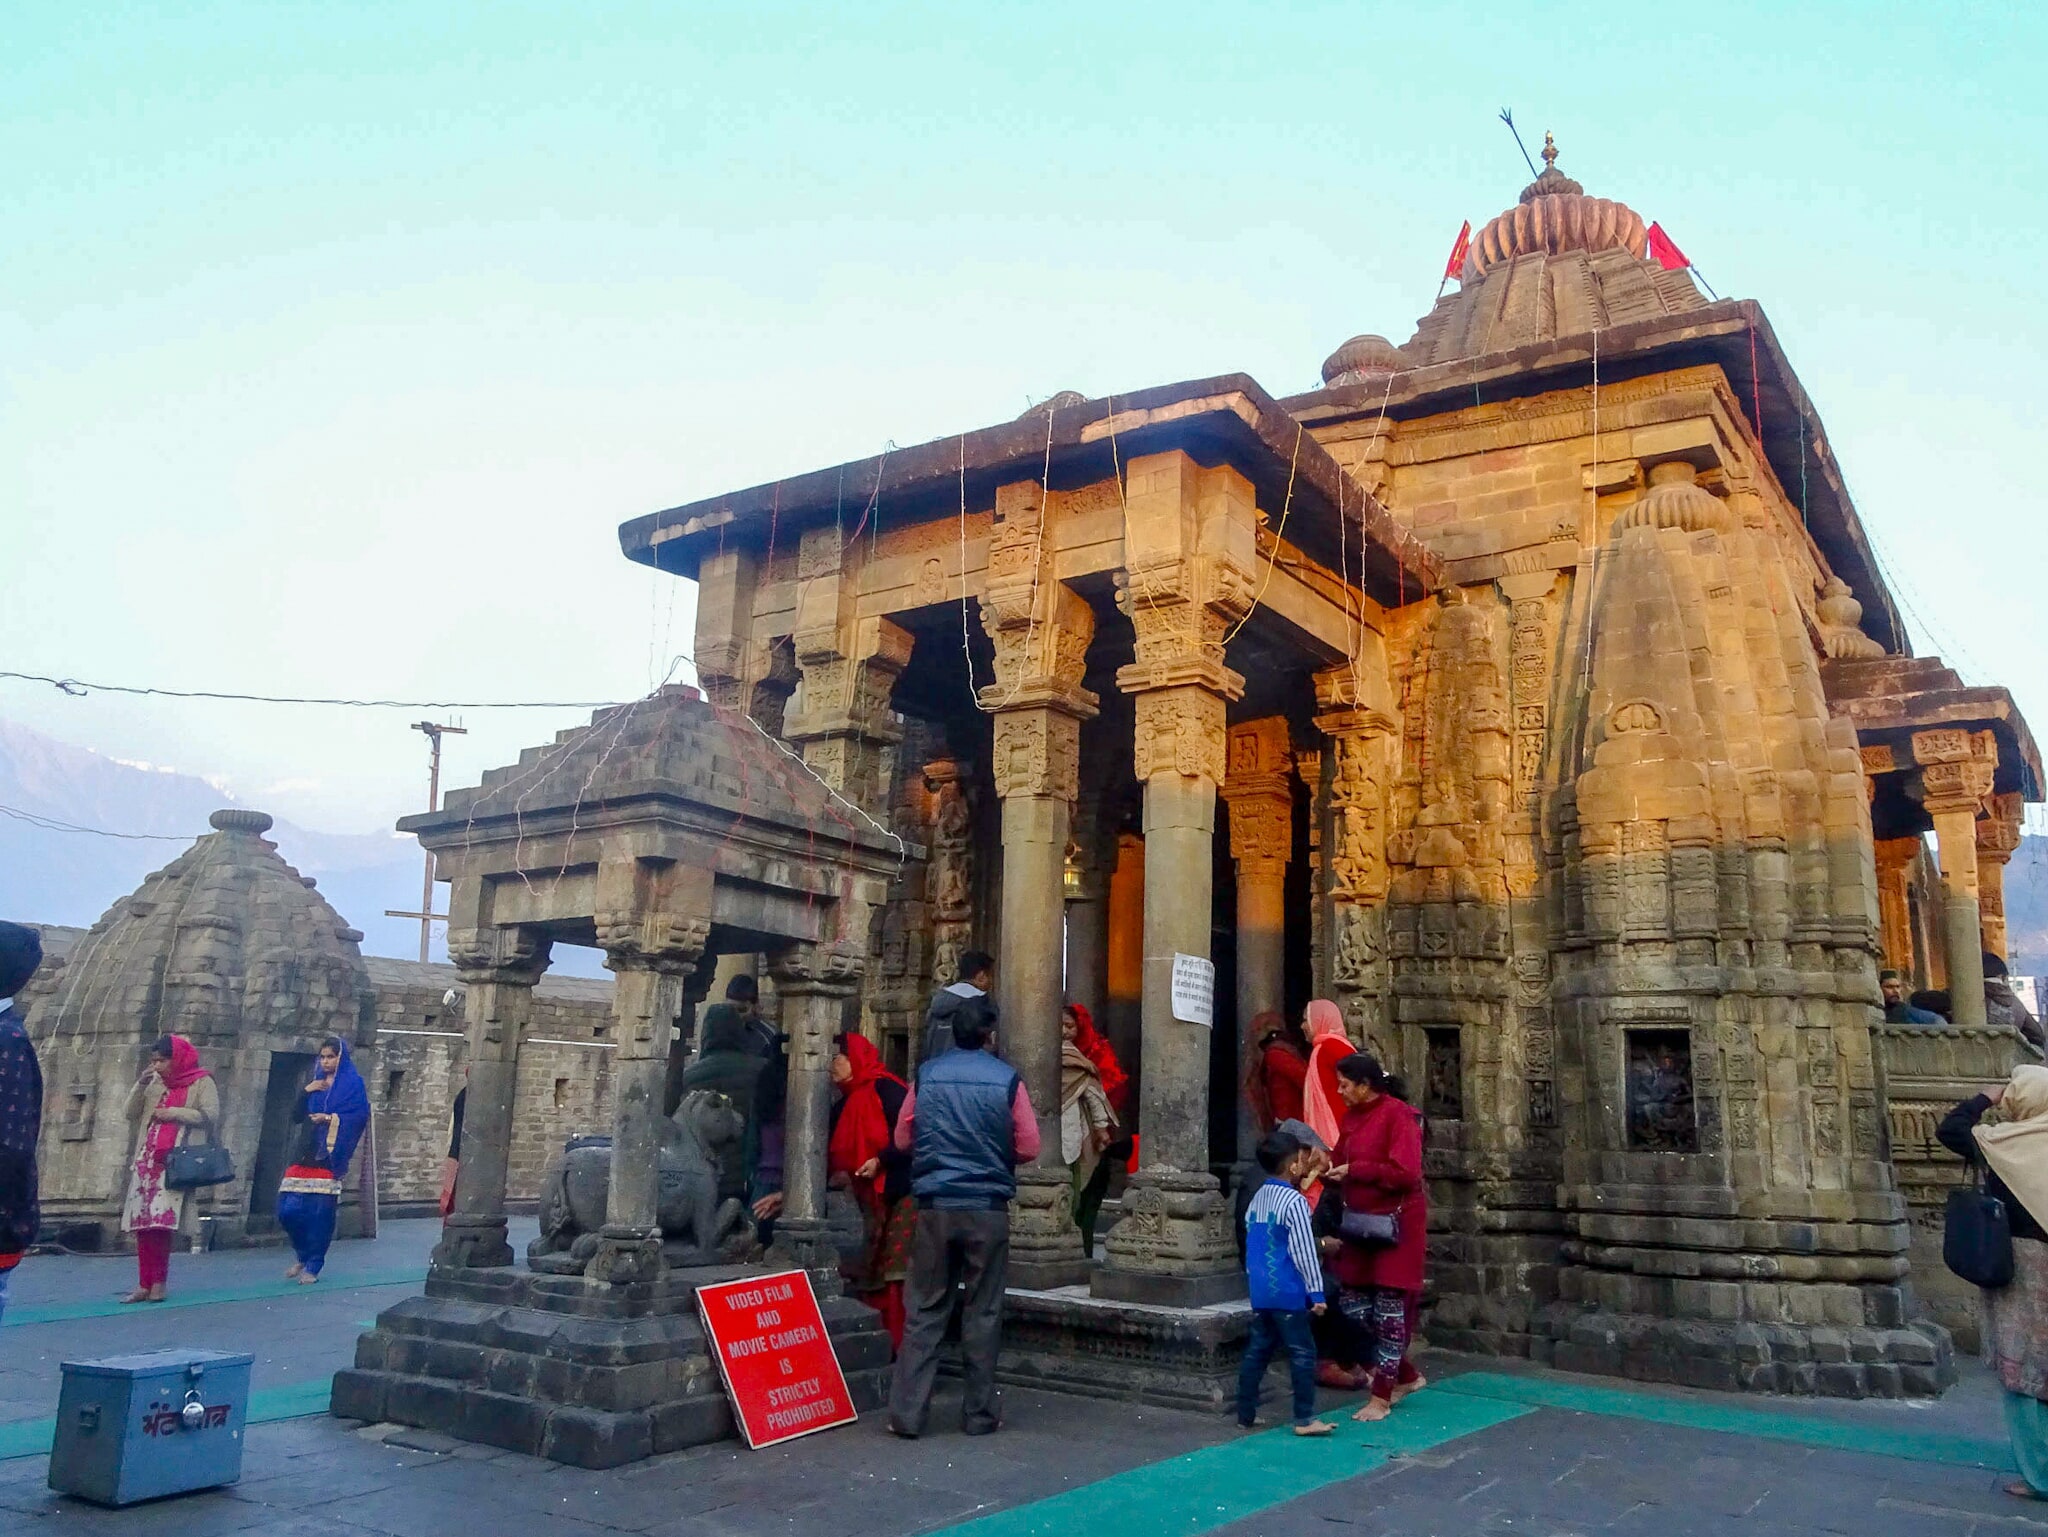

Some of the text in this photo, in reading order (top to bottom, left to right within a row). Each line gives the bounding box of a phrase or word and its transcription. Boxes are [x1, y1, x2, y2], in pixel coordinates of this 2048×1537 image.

[725, 1283, 794, 1311] VIDEO FILM
[756, 1309, 782, 1329] AND
[727, 1325, 819, 1359] MOVIE CAMERA
[778, 1357, 794, 1376] IS
[767, 1377, 821, 1407] STRICTLY
[766, 1397, 837, 1431] PROHIBITED
